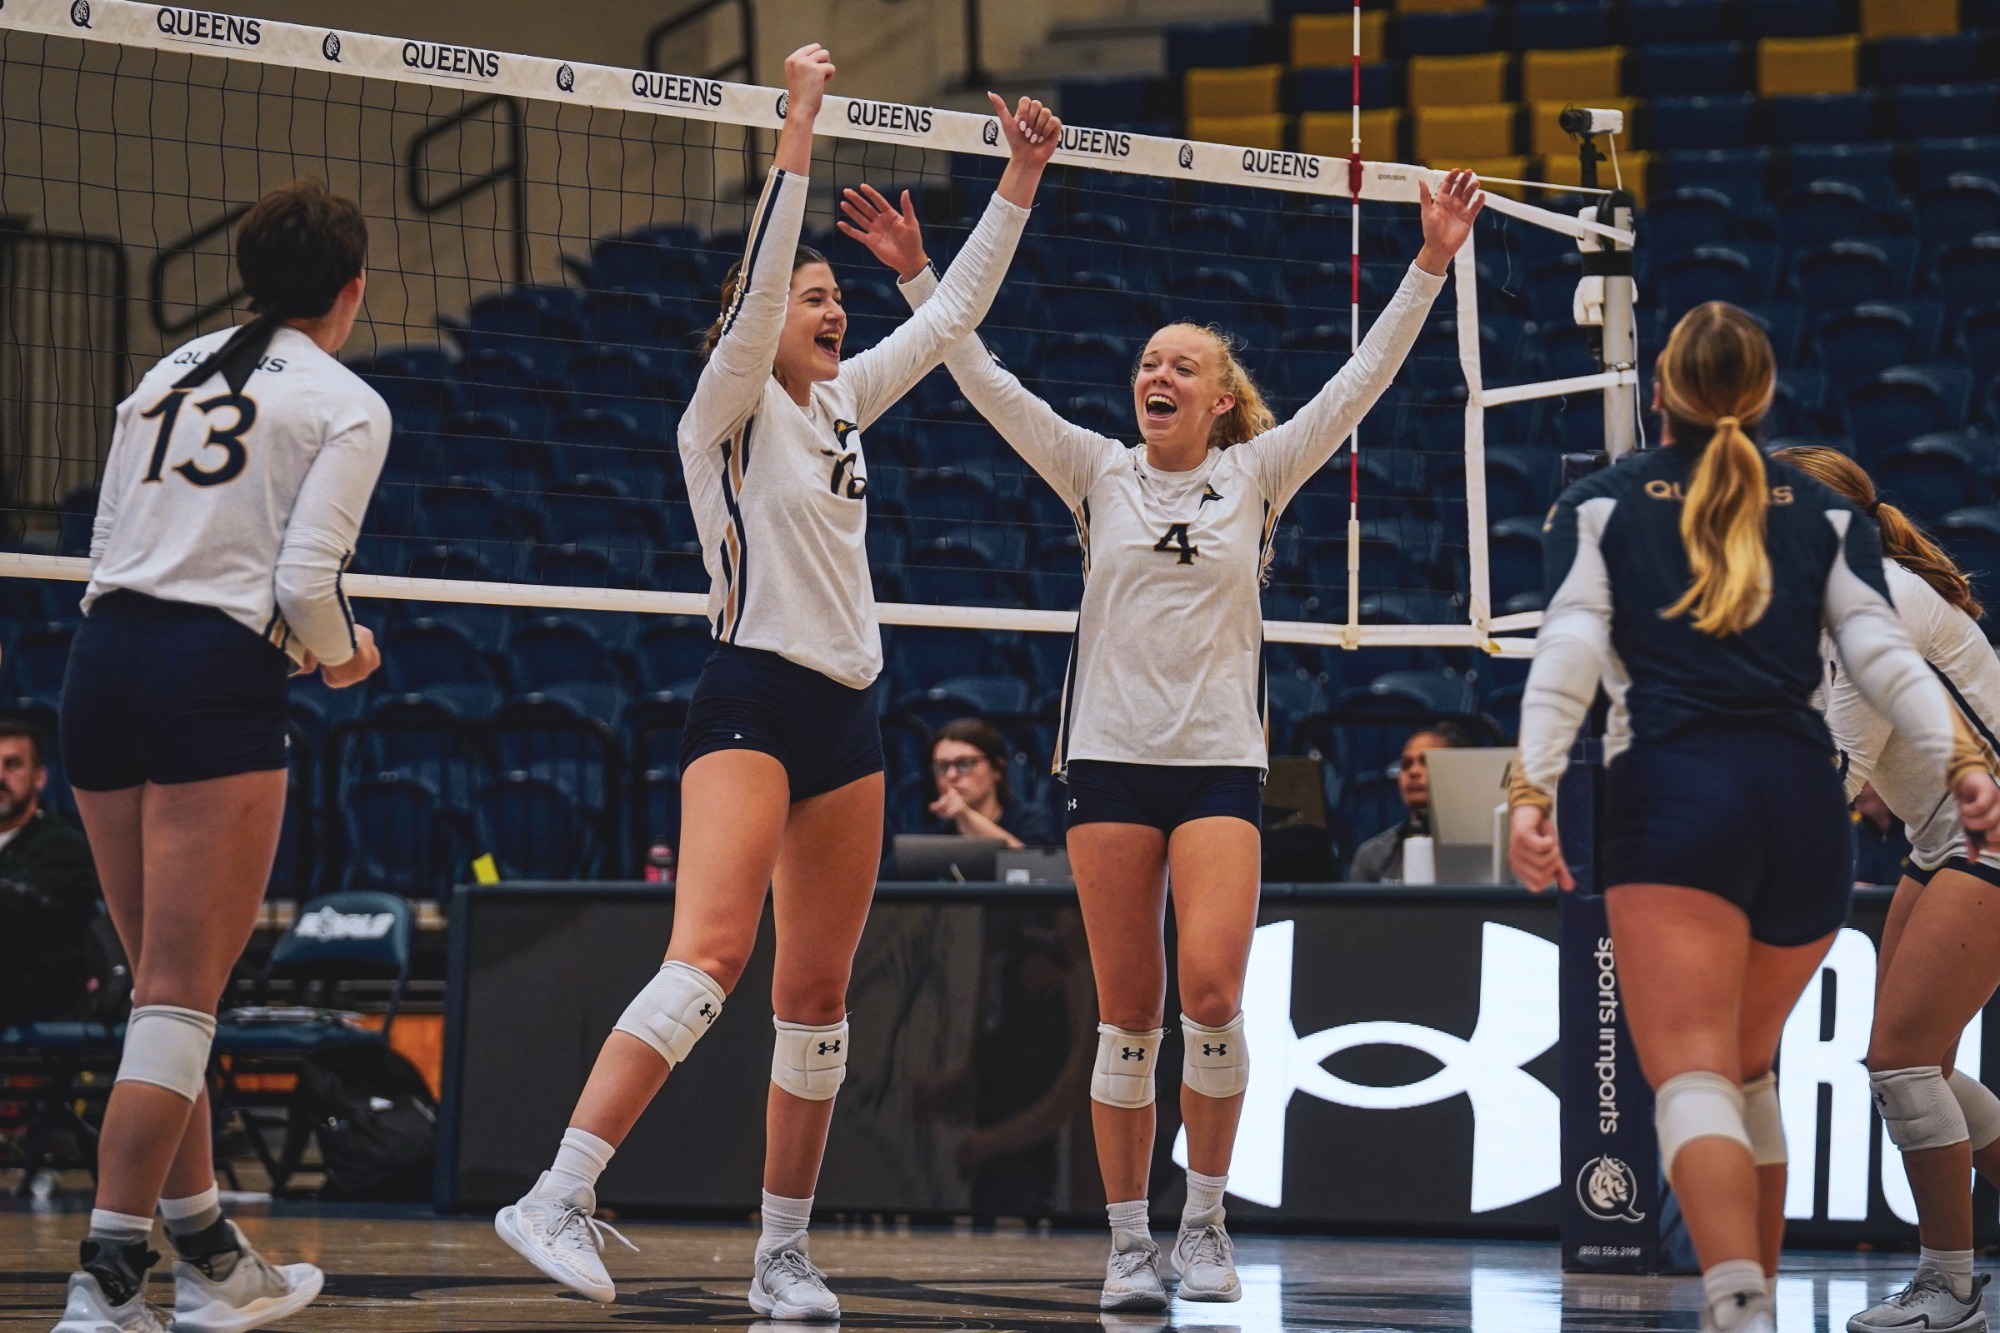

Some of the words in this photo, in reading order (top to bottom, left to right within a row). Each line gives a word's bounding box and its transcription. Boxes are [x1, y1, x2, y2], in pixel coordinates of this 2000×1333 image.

[156, 7, 262, 46] QUEENS
[402, 41, 500, 78] QUEENS
[631, 72, 723, 107] QUEENS
[847, 100, 933, 133] QUEENS
[1242, 149, 1320, 179] QUEENS
[140, 388, 258, 488] 13
[1153, 522, 1200, 566] 4
[1594, 936, 1619, 1024] sports
[1594, 1028, 1620, 1135] imports
